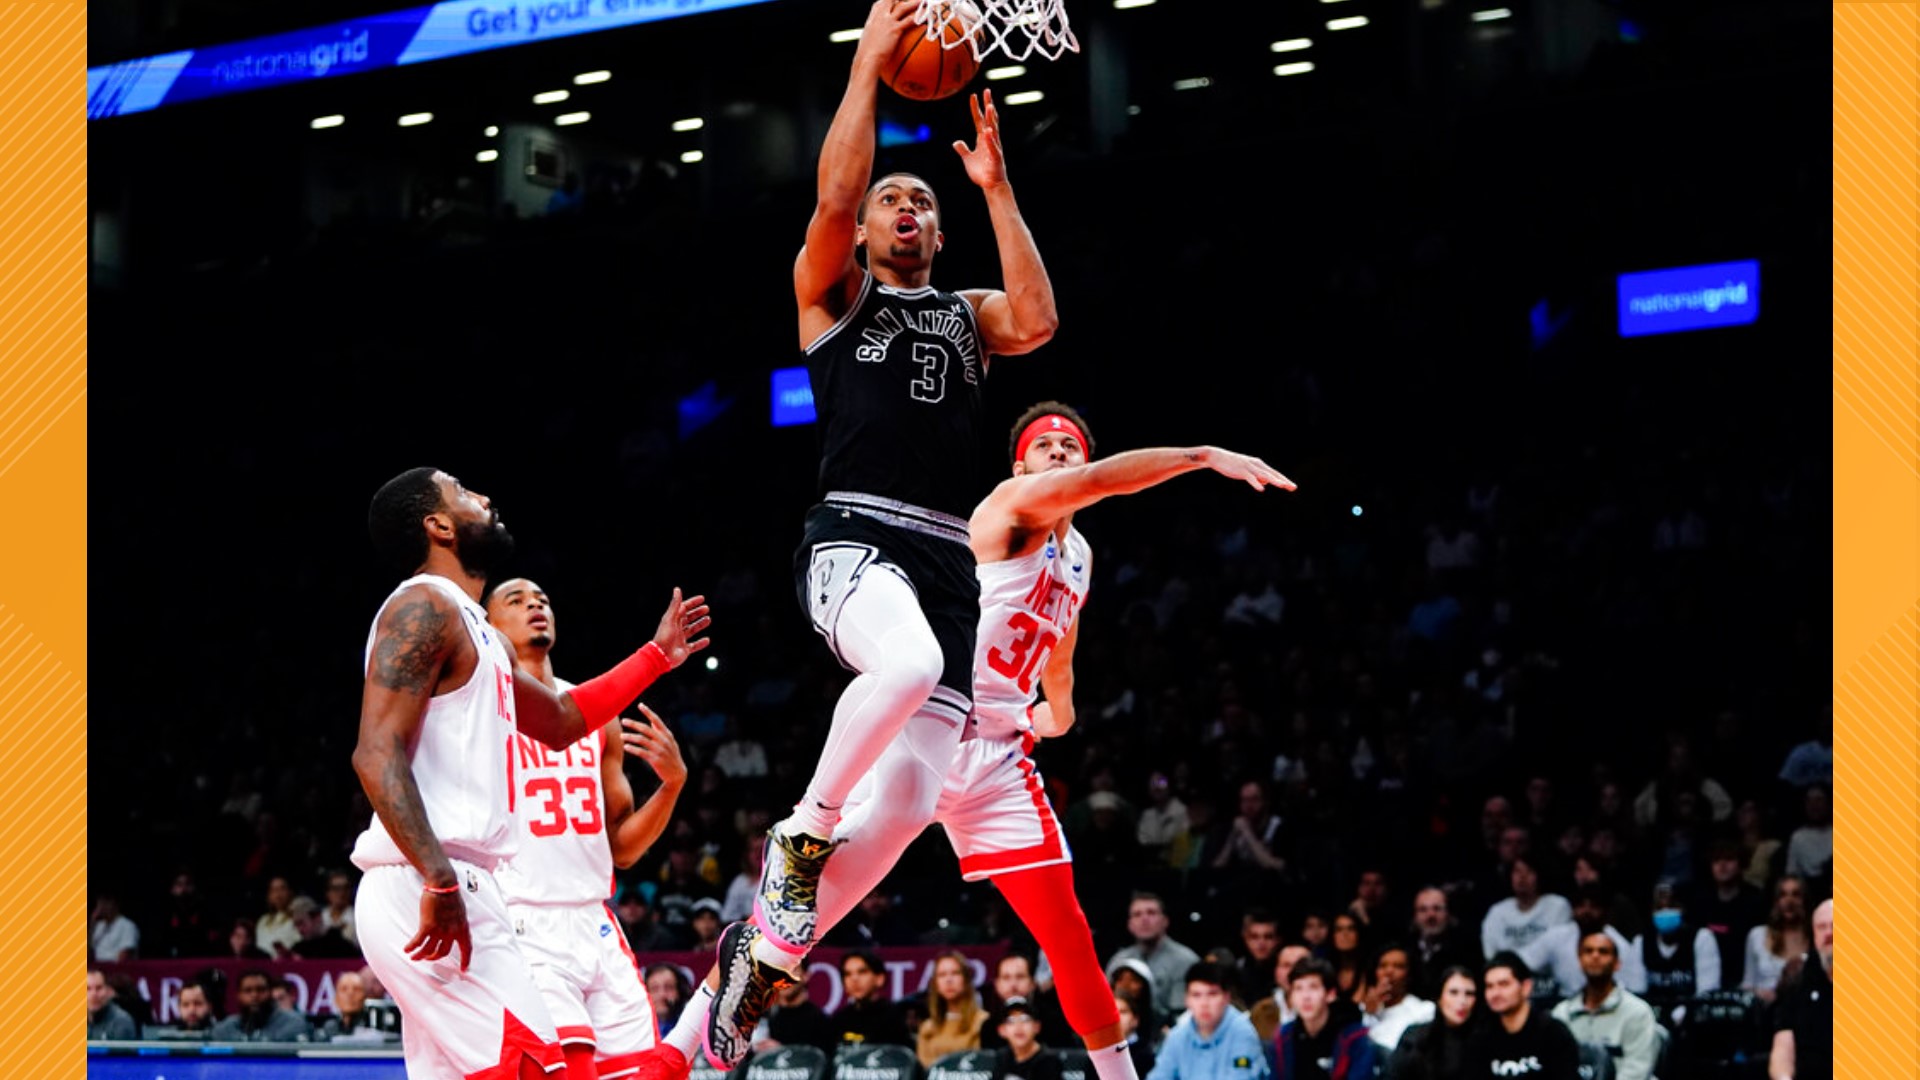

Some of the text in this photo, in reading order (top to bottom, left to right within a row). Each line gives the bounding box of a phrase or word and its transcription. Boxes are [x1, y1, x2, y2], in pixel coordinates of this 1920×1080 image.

[466, 5, 518, 37] Get
[856, 306, 905, 363] SAN
[910, 342, 949, 404] 3
[1024, 566, 1079, 636] NETS
[524, 777, 604, 839] 33
